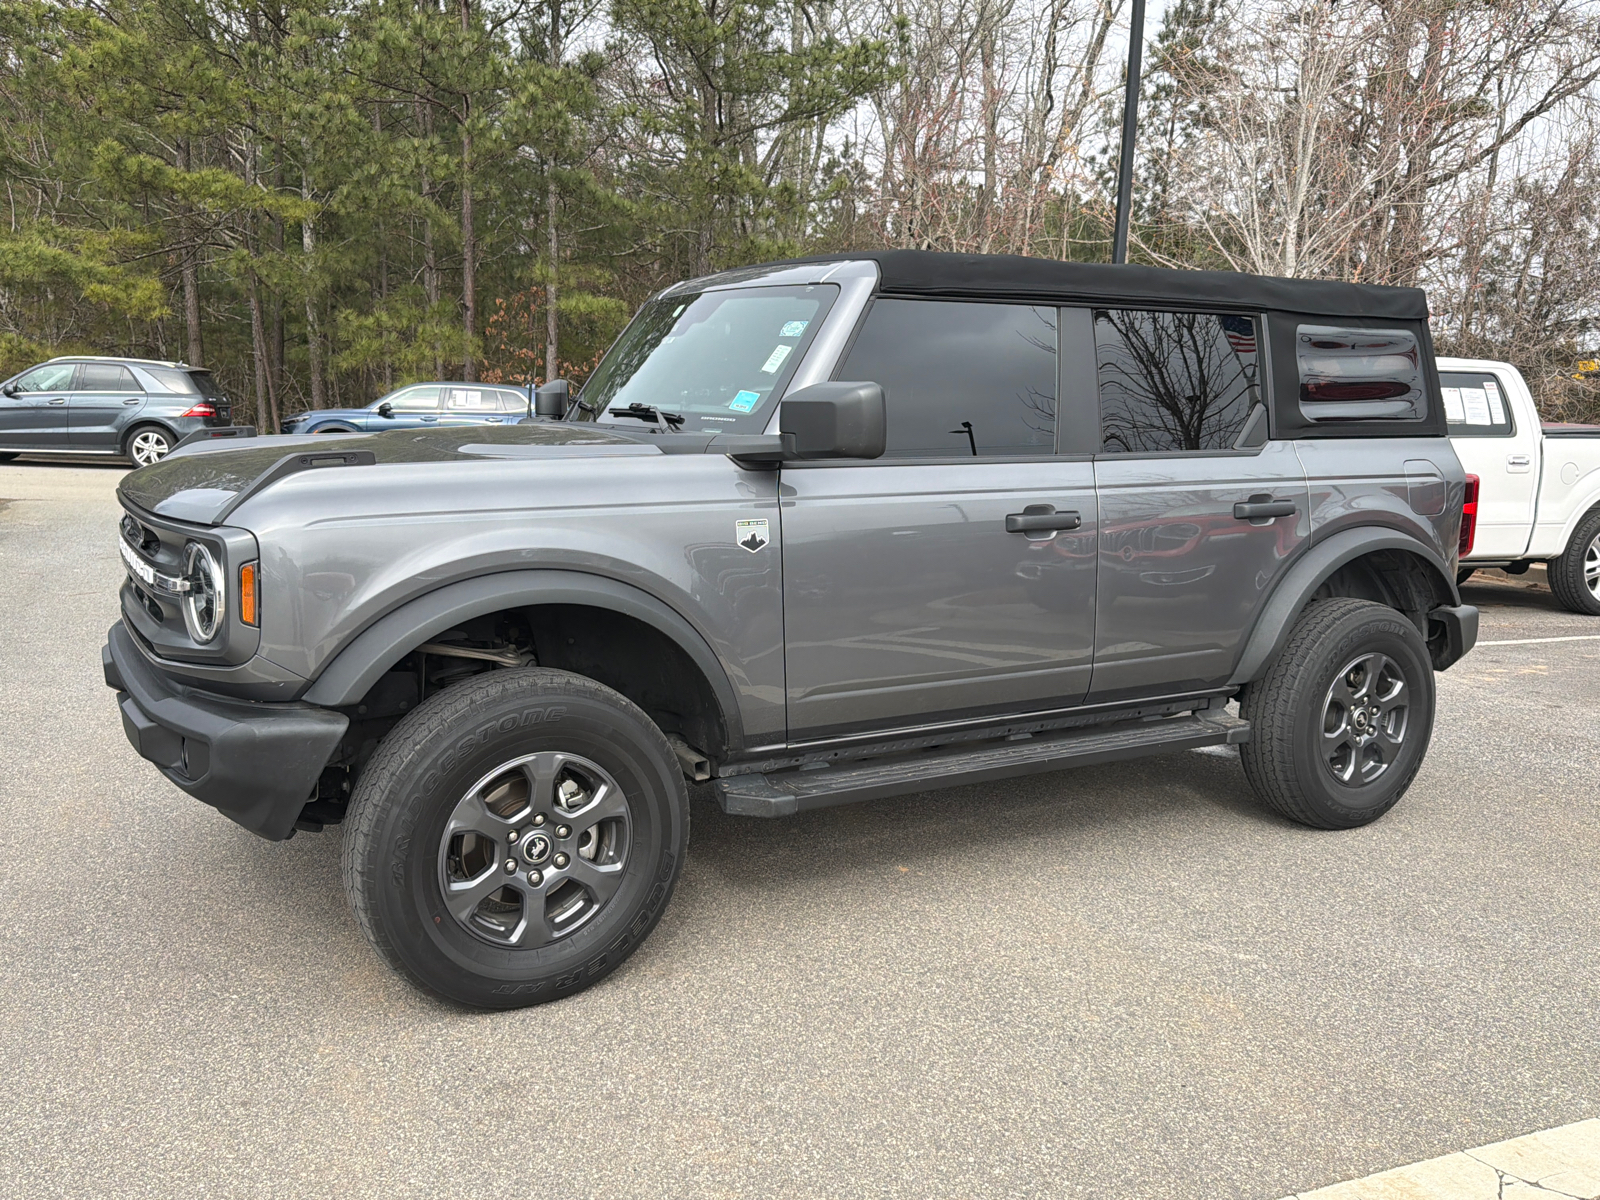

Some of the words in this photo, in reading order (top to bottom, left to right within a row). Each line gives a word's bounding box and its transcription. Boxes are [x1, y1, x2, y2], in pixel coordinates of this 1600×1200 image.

[391, 706, 567, 888] BRIDGESTONE
[492, 980, 546, 995] A/T
[555, 851, 675, 990] DUELER
